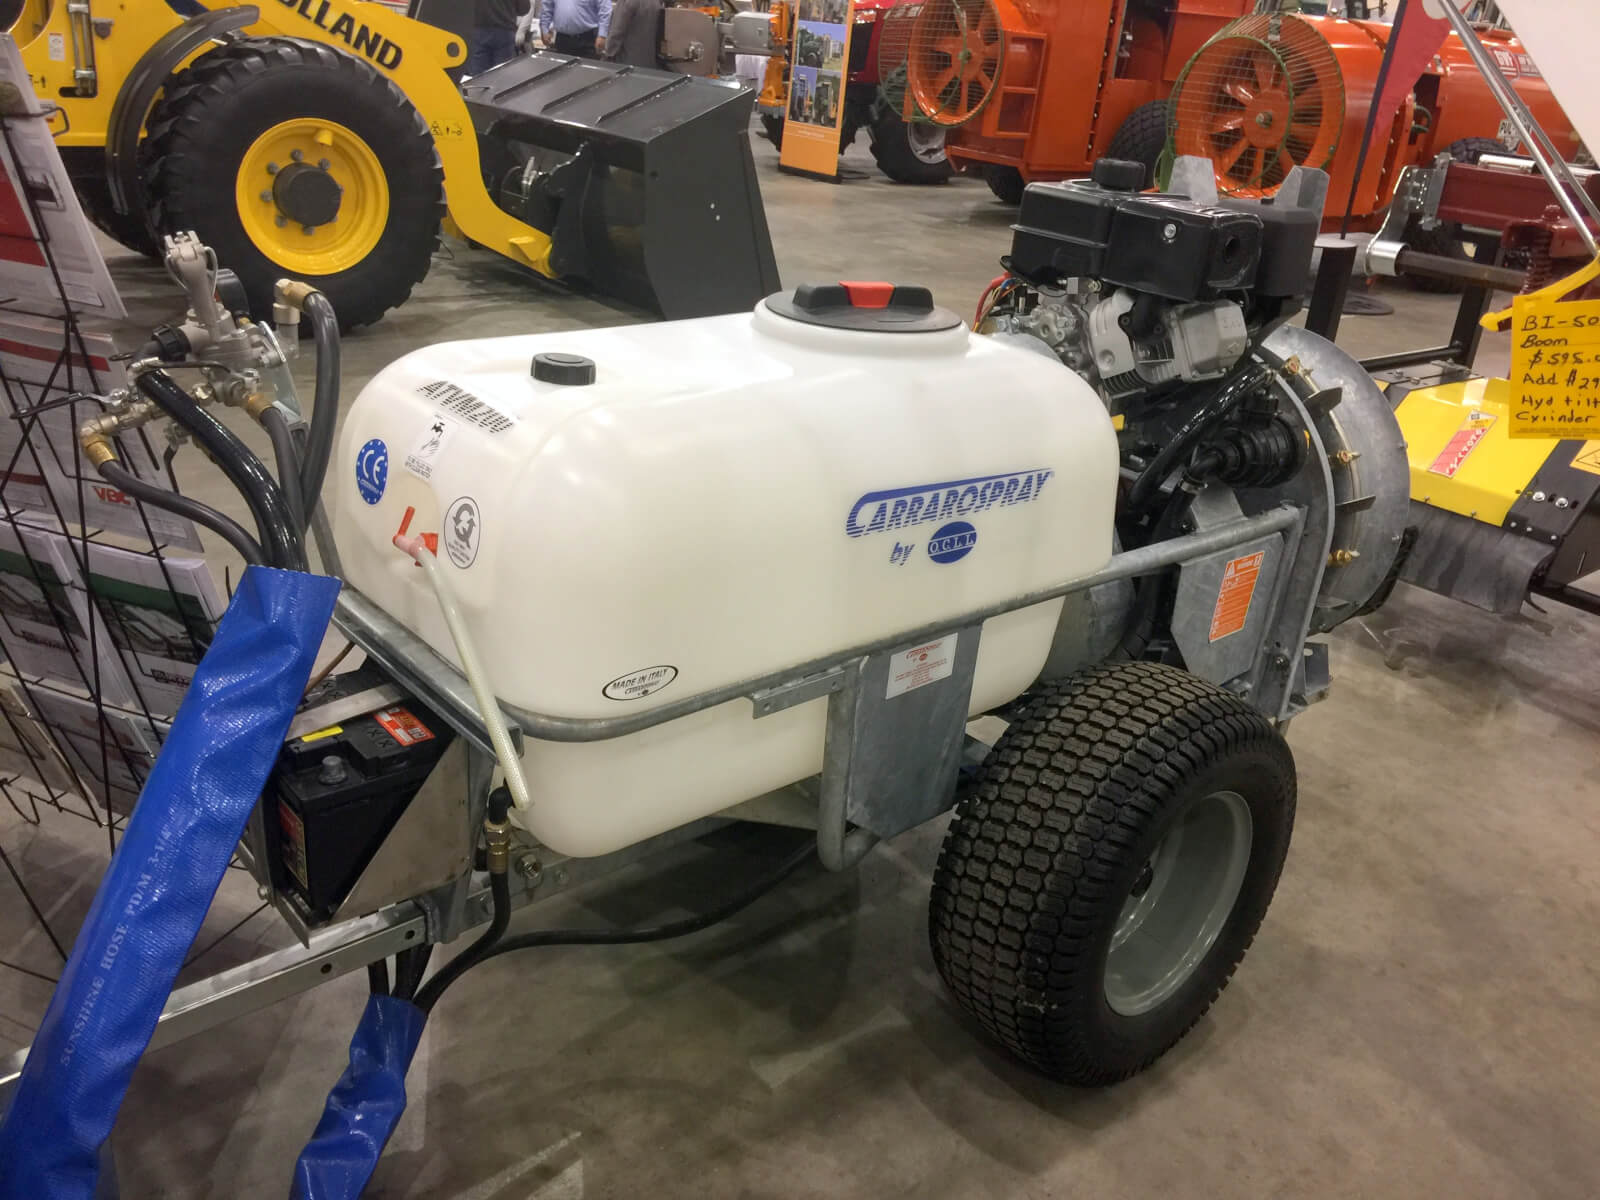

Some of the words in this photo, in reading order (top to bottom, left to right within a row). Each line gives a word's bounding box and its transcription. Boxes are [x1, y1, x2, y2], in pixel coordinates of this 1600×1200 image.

[1520, 334, 1569, 349] Boom
[1523, 373, 1559, 385] Add
[1521, 395, 1554, 410] Hyd
[845, 467, 1053, 538] CARRAROSPRAY
[889, 542, 915, 566] by
[61, 976, 104, 1066] SUNSHINE
[101, 922, 129, 970] HOSE
